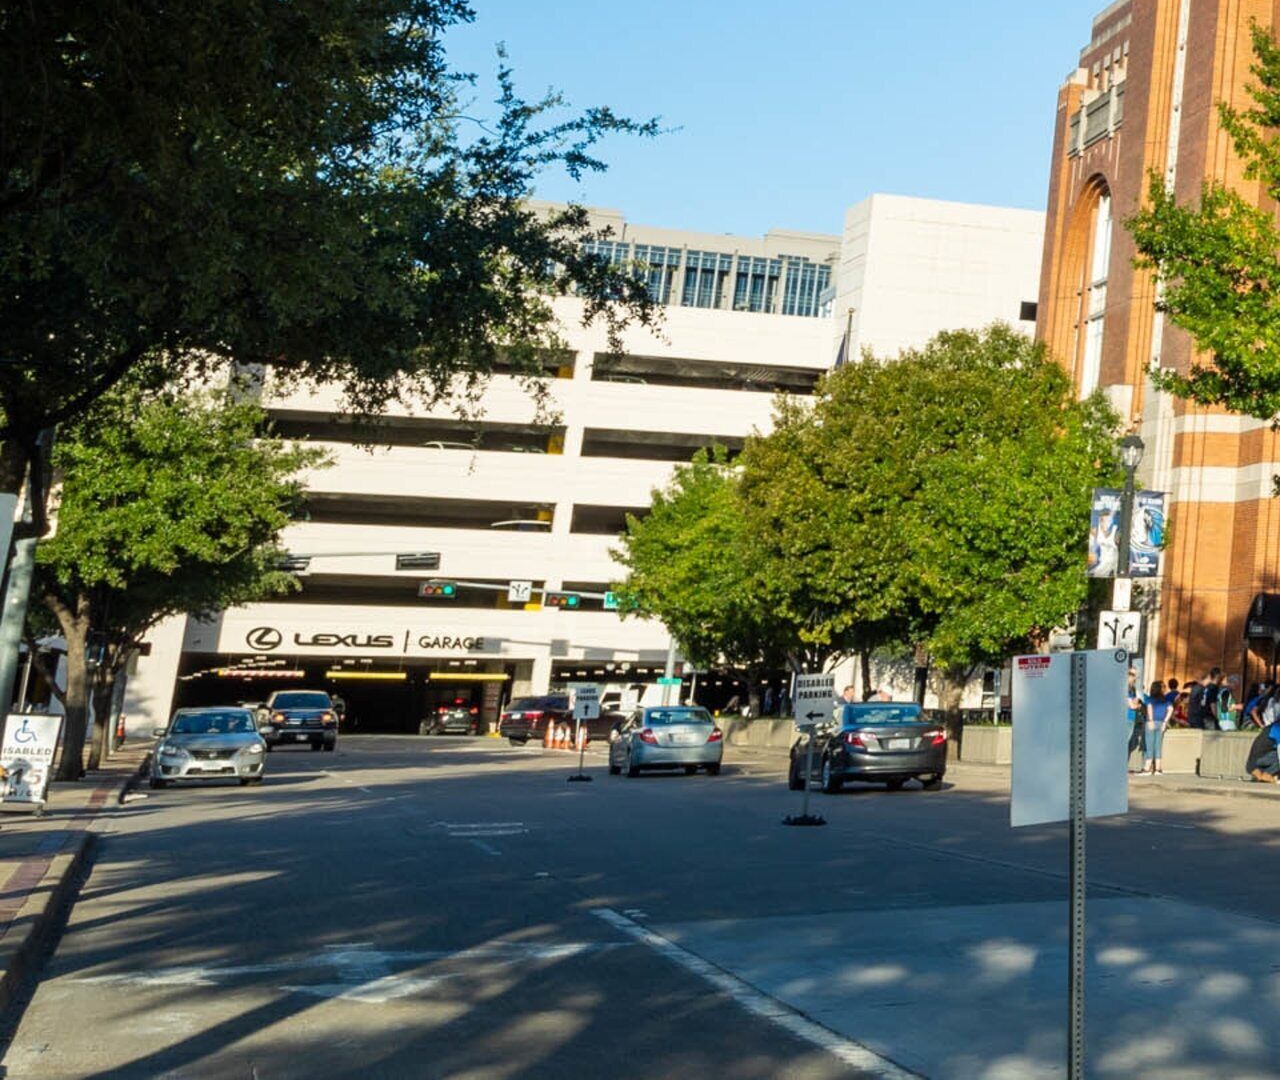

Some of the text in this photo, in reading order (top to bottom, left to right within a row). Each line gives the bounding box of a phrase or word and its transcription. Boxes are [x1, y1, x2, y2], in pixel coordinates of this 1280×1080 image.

[294, 632, 484, 650] LEXUS GARAGE
[797, 679, 834, 688] DISABLED
[798, 690, 833, 699] PARKING
[3, 747, 52, 756] ISABLED
